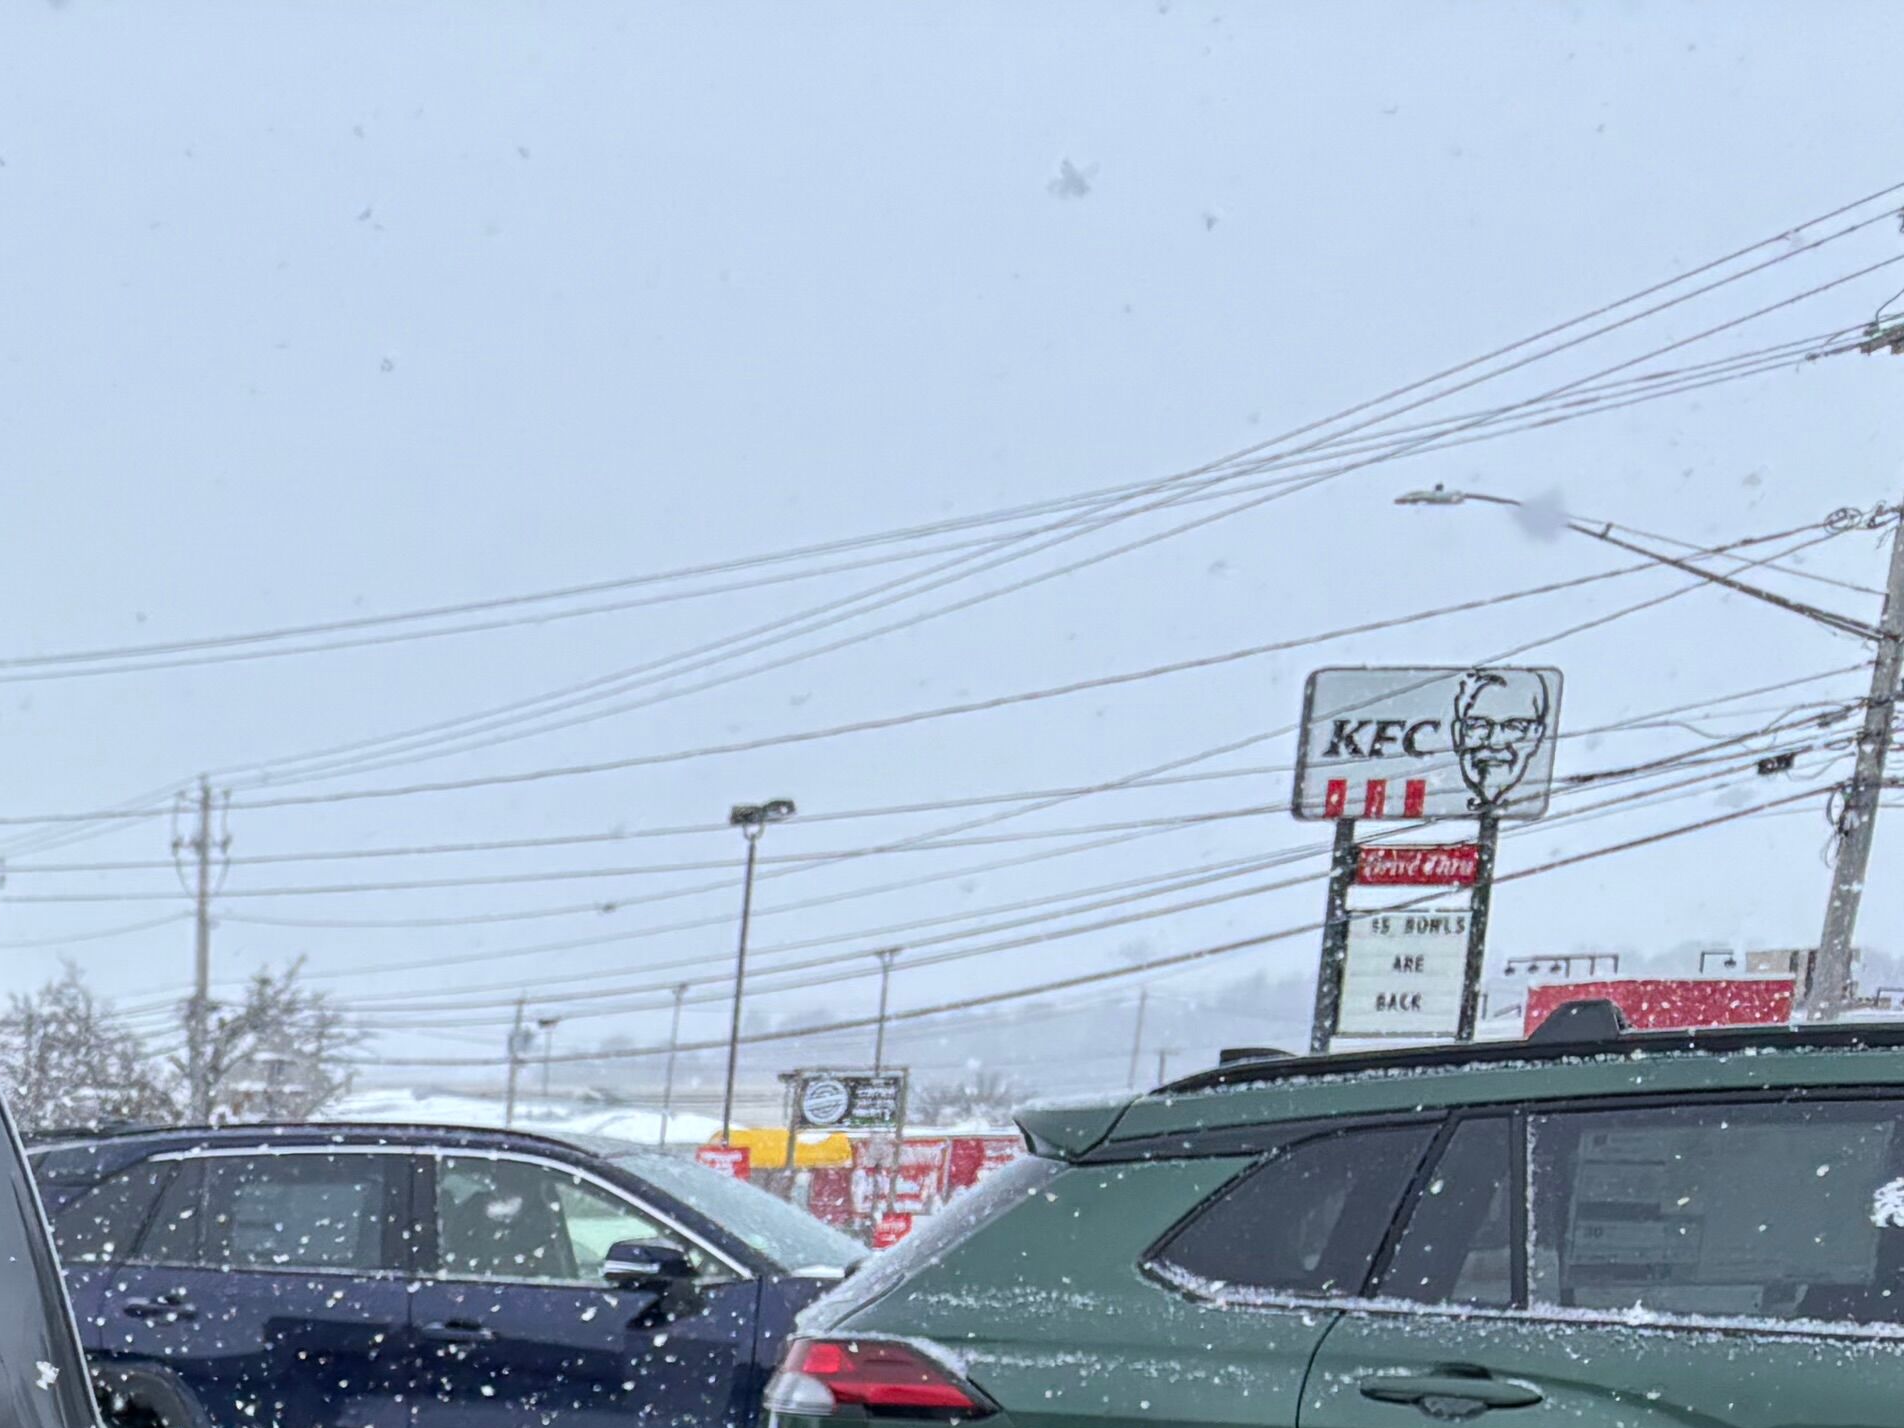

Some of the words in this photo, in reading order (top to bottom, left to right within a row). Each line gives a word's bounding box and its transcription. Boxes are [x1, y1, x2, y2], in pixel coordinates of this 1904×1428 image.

[1323, 719, 1442, 758] KFC
[1393, 954, 1425, 973] ARE
[1375, 992, 1423, 1012] BACK
